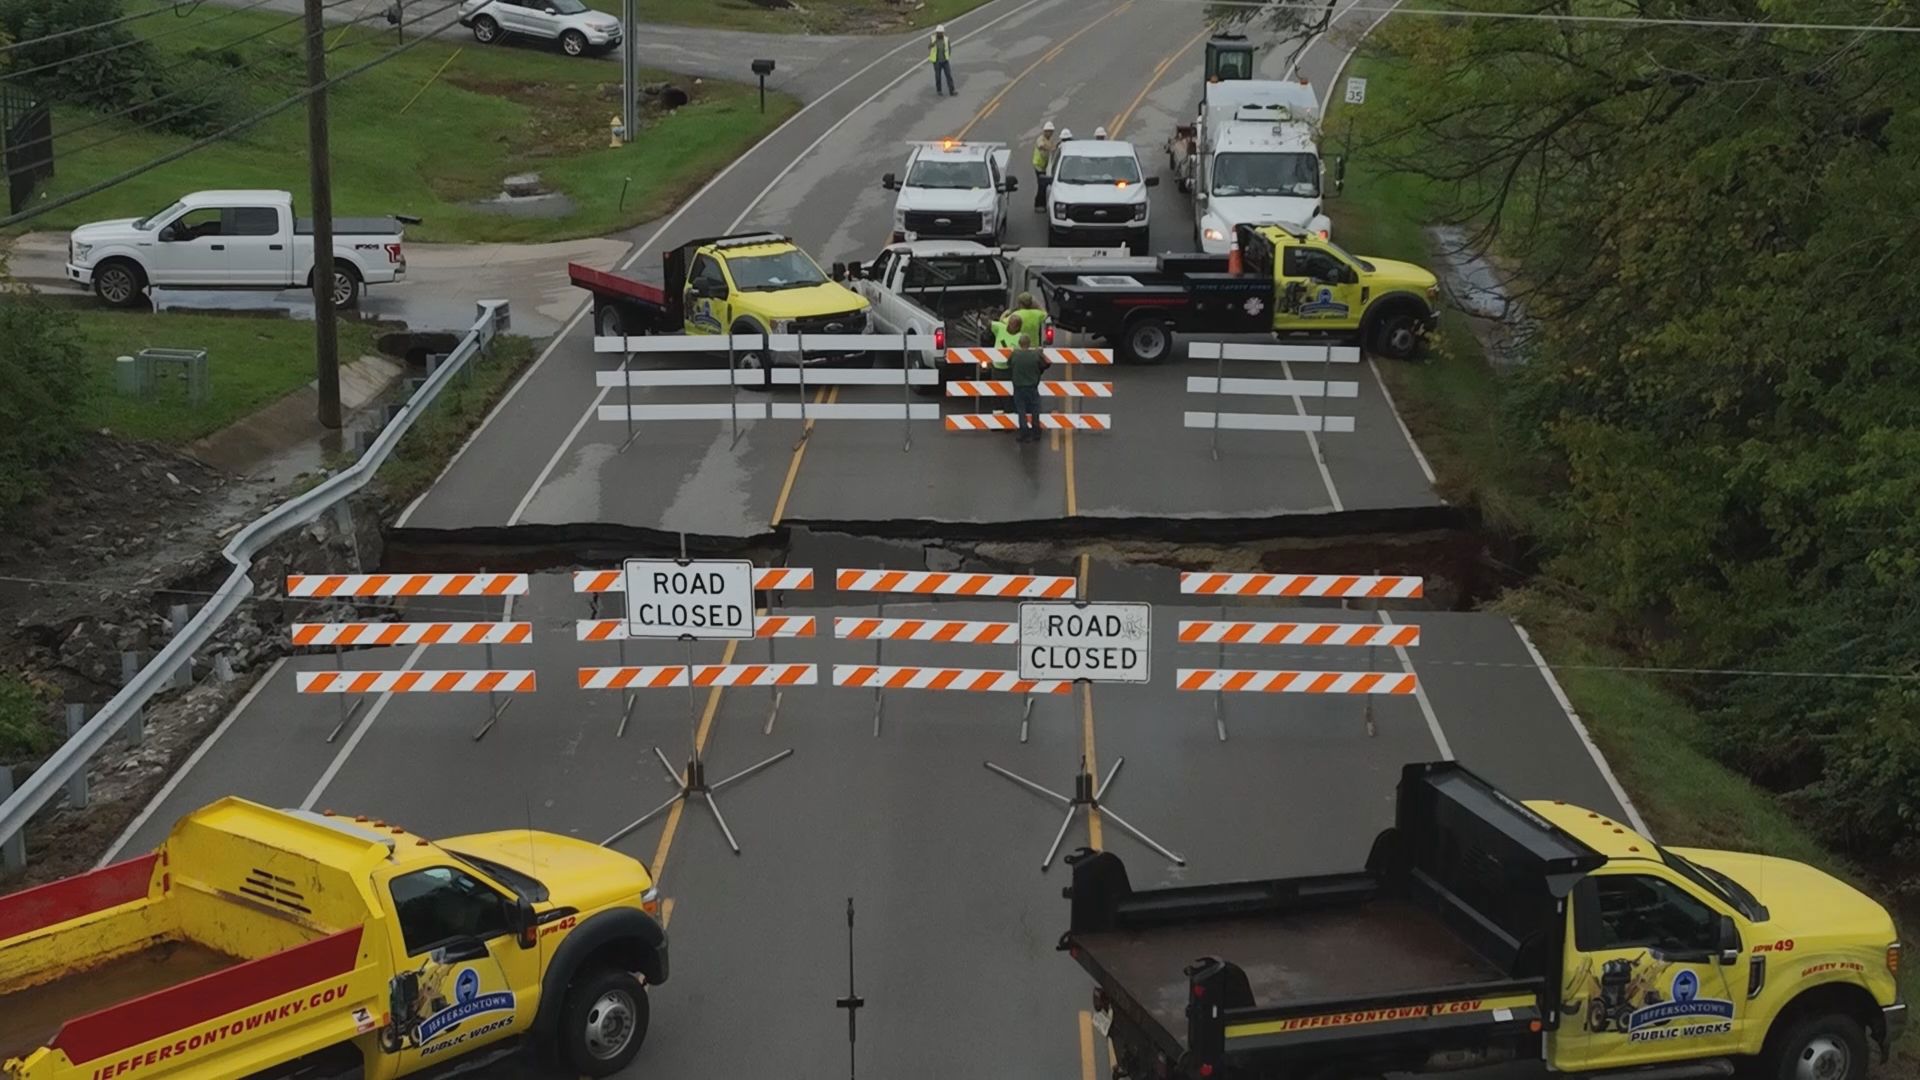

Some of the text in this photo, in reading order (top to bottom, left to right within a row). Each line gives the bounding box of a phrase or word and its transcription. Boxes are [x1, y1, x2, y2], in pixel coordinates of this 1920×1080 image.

[1348, 90, 1362, 102] 35
[653, 572, 725, 595] ROAD
[639, 603, 742, 627] CLOSED
[1048, 614, 1122, 637] ROAD
[1031, 646, 1137, 669] CLOSED
[559, 916, 576, 930] 42
[1752, 939, 1794, 953] JPW 49
[1801, 962, 1837, 977] SAFETY
[428, 996, 506, 1033] JEFFERSONTOWN
[1640, 1002, 1726, 1023] JEFFERSONTOWN
[421, 1015, 514, 1057] PUBLIC WORKS
[1631, 1022, 1731, 1042] PUBLIC WORKS
